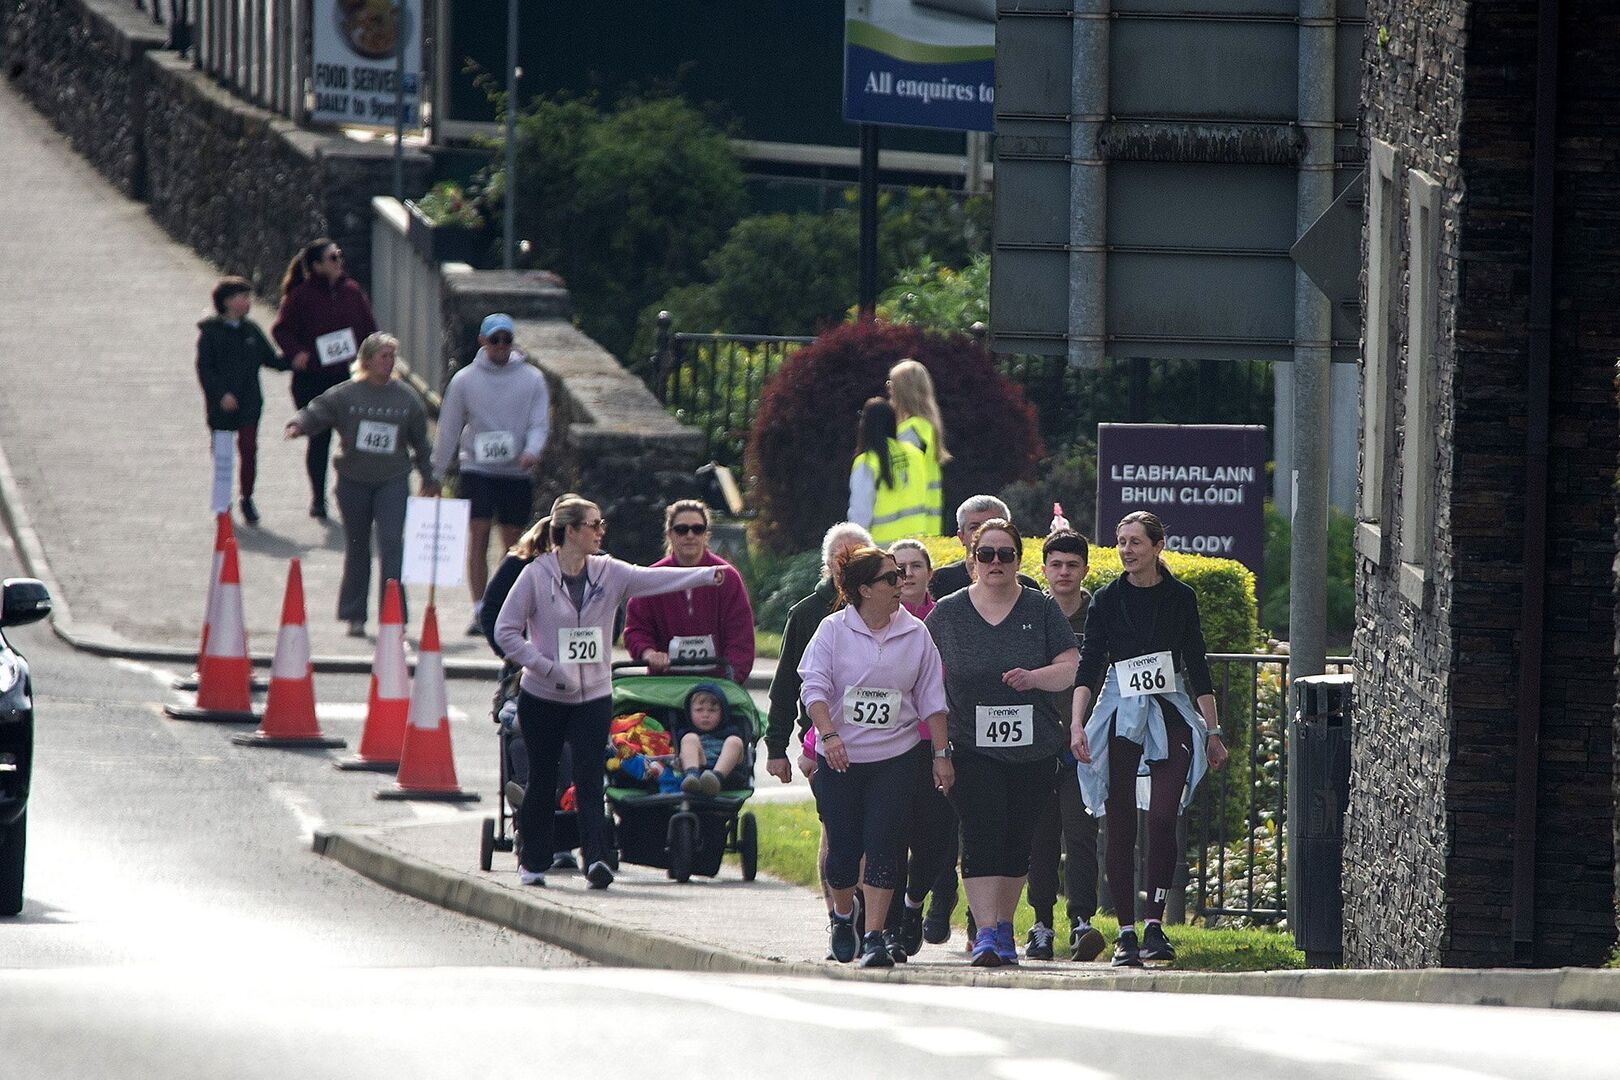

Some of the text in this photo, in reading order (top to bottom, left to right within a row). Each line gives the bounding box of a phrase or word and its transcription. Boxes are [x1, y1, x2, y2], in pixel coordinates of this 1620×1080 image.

[316, 63, 348, 89] FOOD
[352, 66, 397, 93] SERVE
[864, 71, 994, 103] All enquires to
[316, 93, 349, 113] DAILY
[353, 96, 365, 115] to
[363, 432, 390, 448] 483
[1111, 464, 1254, 482] LEABHARLANN
[1121, 484, 1245, 504] BHUN CLÓIDÍ
[1164, 534, 1234, 552] CLODY
[568, 640, 597, 660] 520
[1129, 667, 1166, 691] 486
[852, 701, 890, 724] 523
[986, 720, 1022, 743] 495
